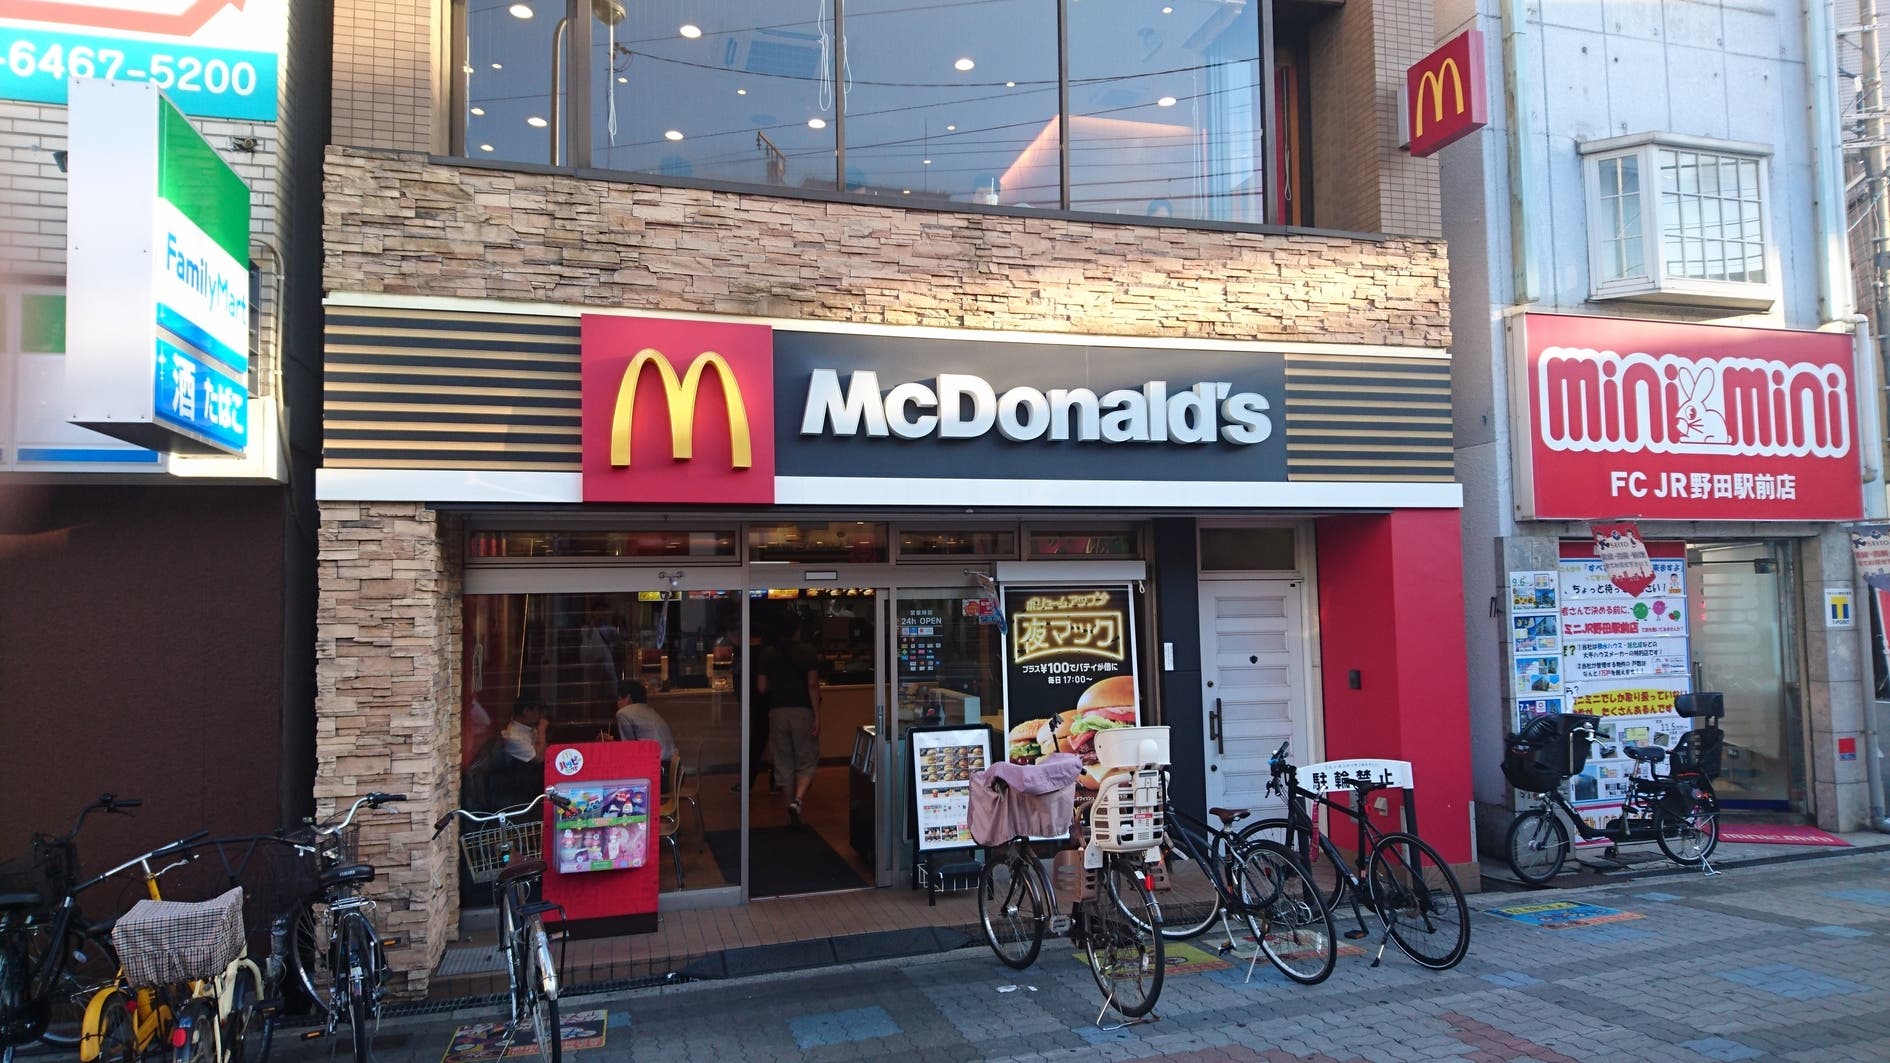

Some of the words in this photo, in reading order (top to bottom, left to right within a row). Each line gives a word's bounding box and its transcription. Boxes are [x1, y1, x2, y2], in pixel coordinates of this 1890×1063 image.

[0, 39, 257, 96] 6467-5200
[167, 232, 247, 326] FamilyMart
[172, 352, 196, 422] 酒
[204, 377, 244, 434] たばこ
[800, 368, 1272, 445] McDonald's
[1610, 471, 1648, 498] FC
[901, 617, 917, 625] 24h
[919, 617, 943, 625] OPEN
[1019, 618, 1115, 654] 夜マック
